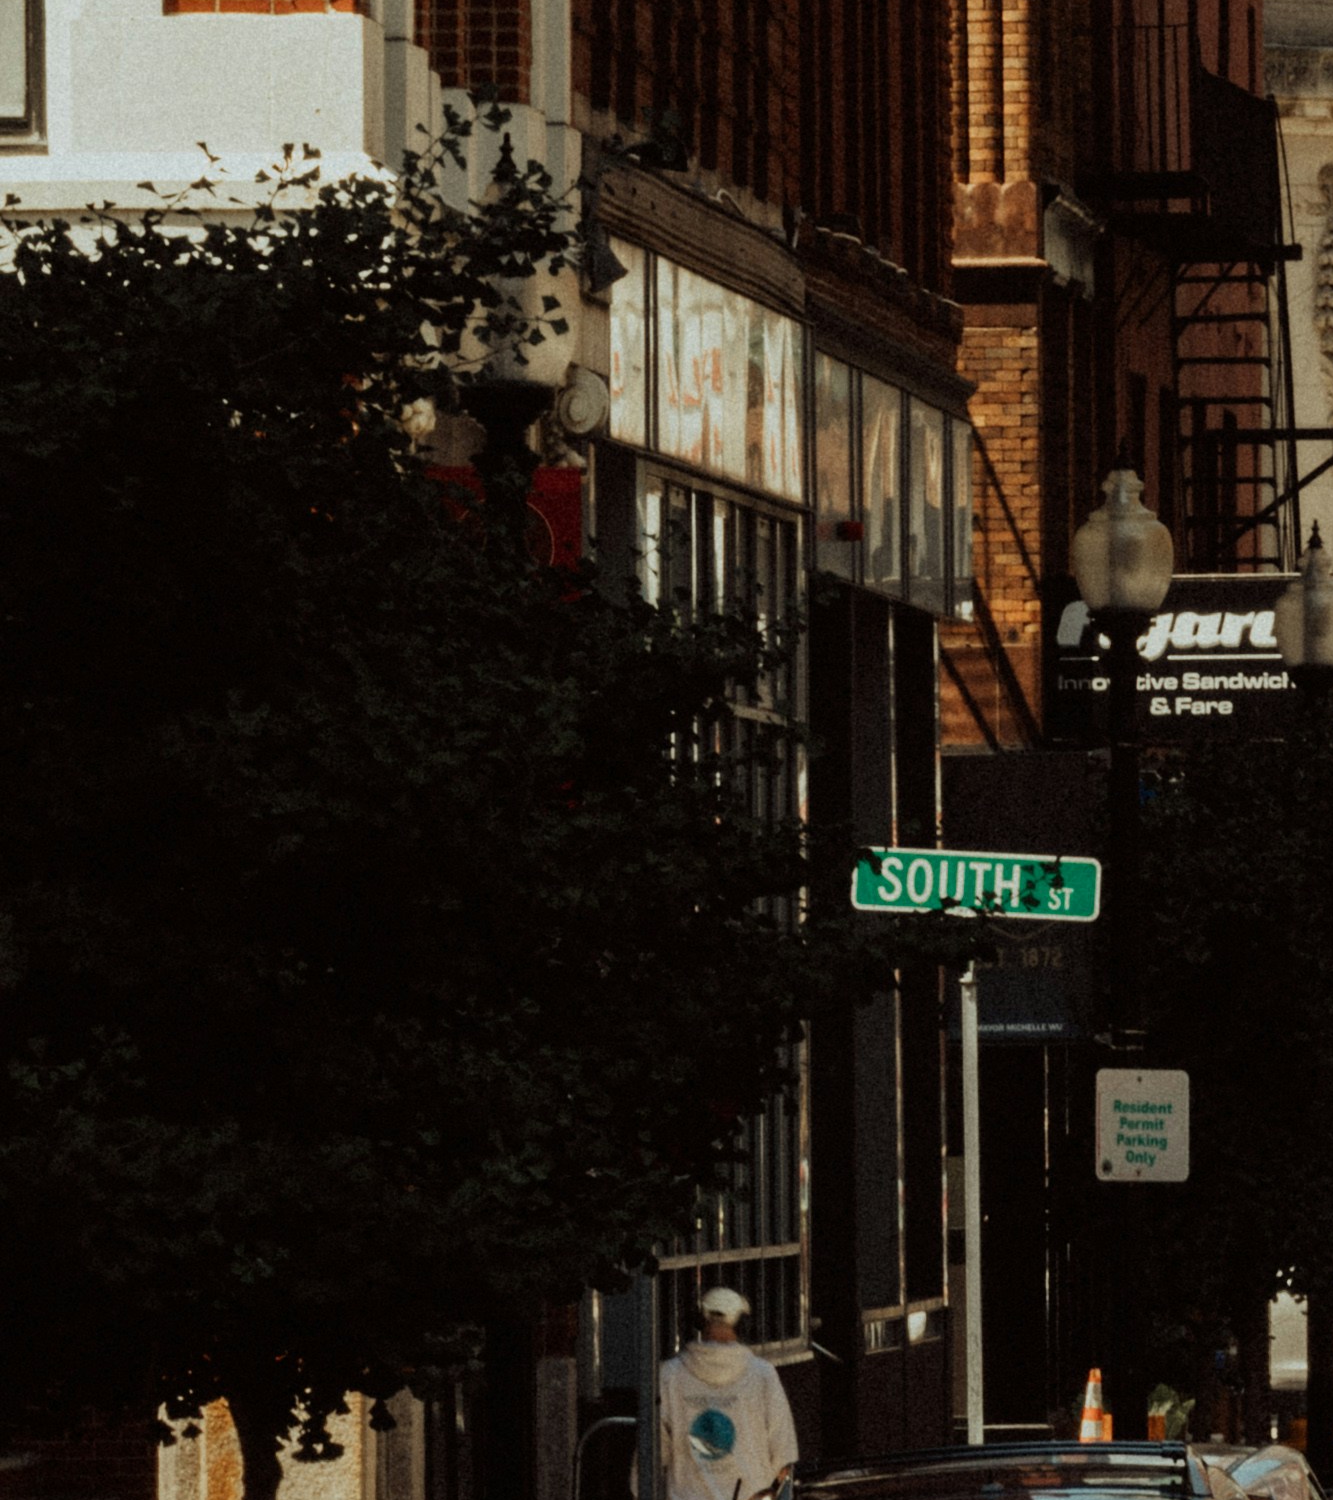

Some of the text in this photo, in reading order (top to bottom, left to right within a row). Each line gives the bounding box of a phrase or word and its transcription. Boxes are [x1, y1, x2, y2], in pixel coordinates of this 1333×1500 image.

[1150, 697, 1233, 716] & Fare
[878, 857, 1075, 910] SOUTH ST
[1114, 1100, 1172, 1114] Resident
[1120, 1117, 1164, 1130] Permit
[1117, 1134, 1167, 1150] Parking
[1126, 1150, 1156, 1167] Only
